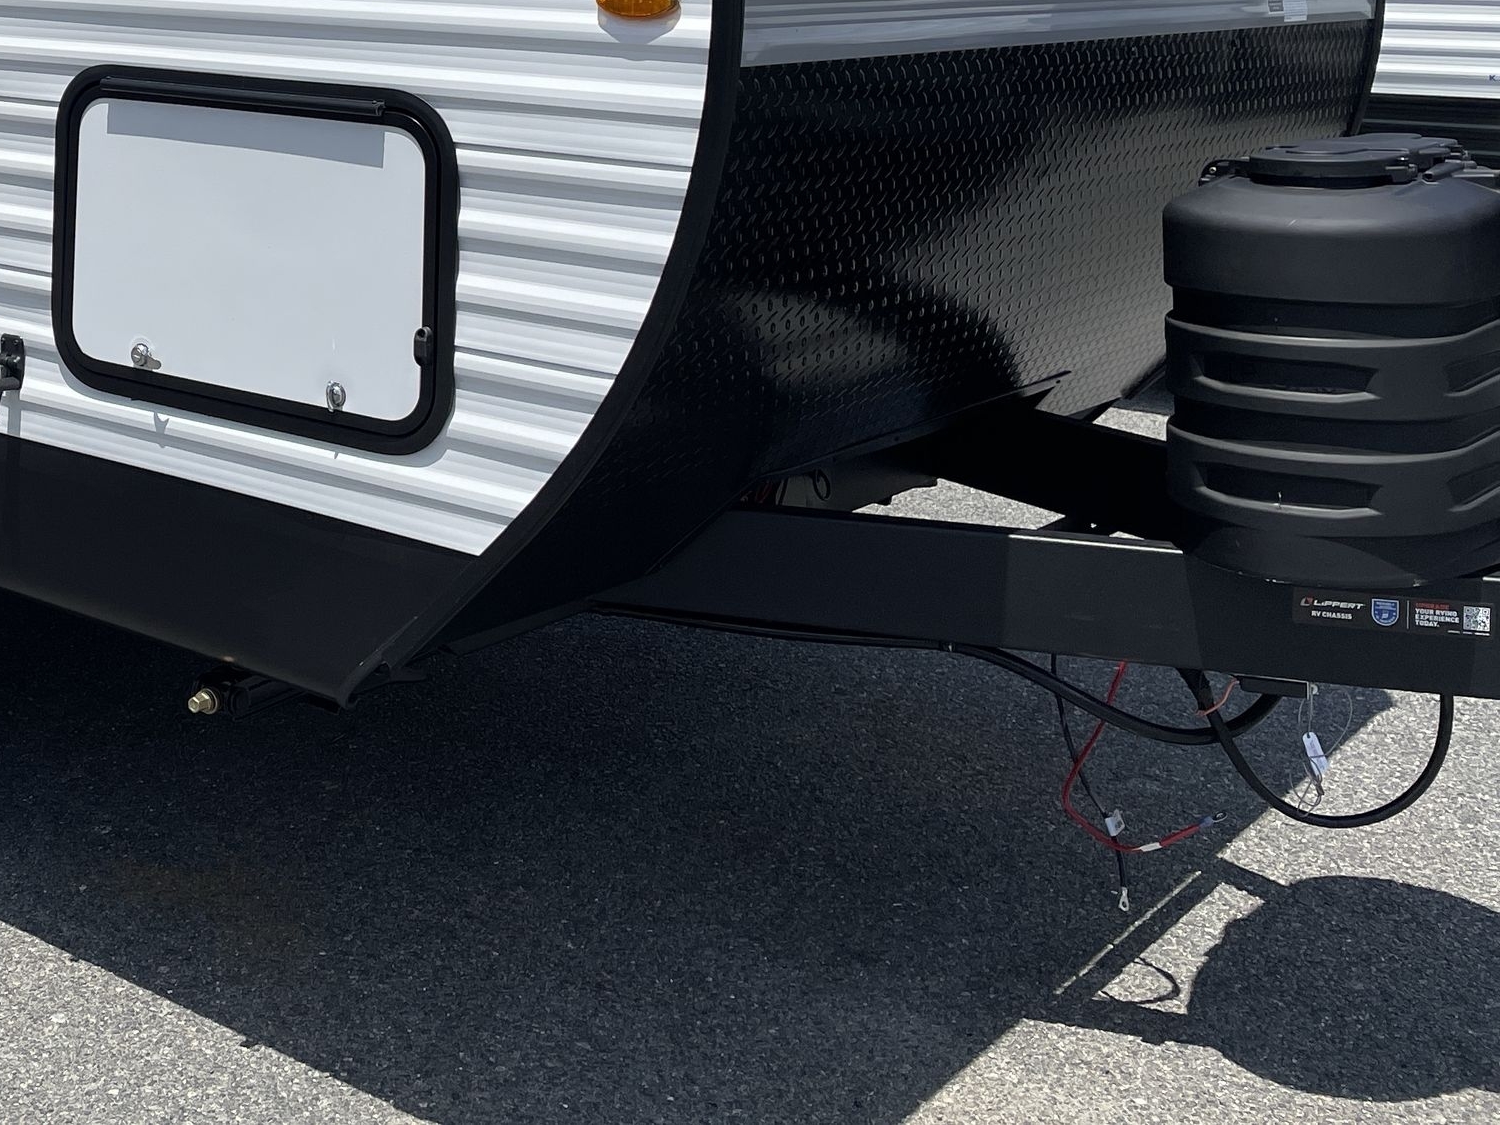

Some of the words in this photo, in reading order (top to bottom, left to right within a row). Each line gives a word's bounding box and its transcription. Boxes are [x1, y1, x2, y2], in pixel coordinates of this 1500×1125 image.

[1313, 599, 1364, 610] LIPPERT
[1321, 611, 1352, 620] CHASSIS
[1415, 607, 1434, 615] YOUR
[1415, 613, 1459, 624] EXPERIENCE
